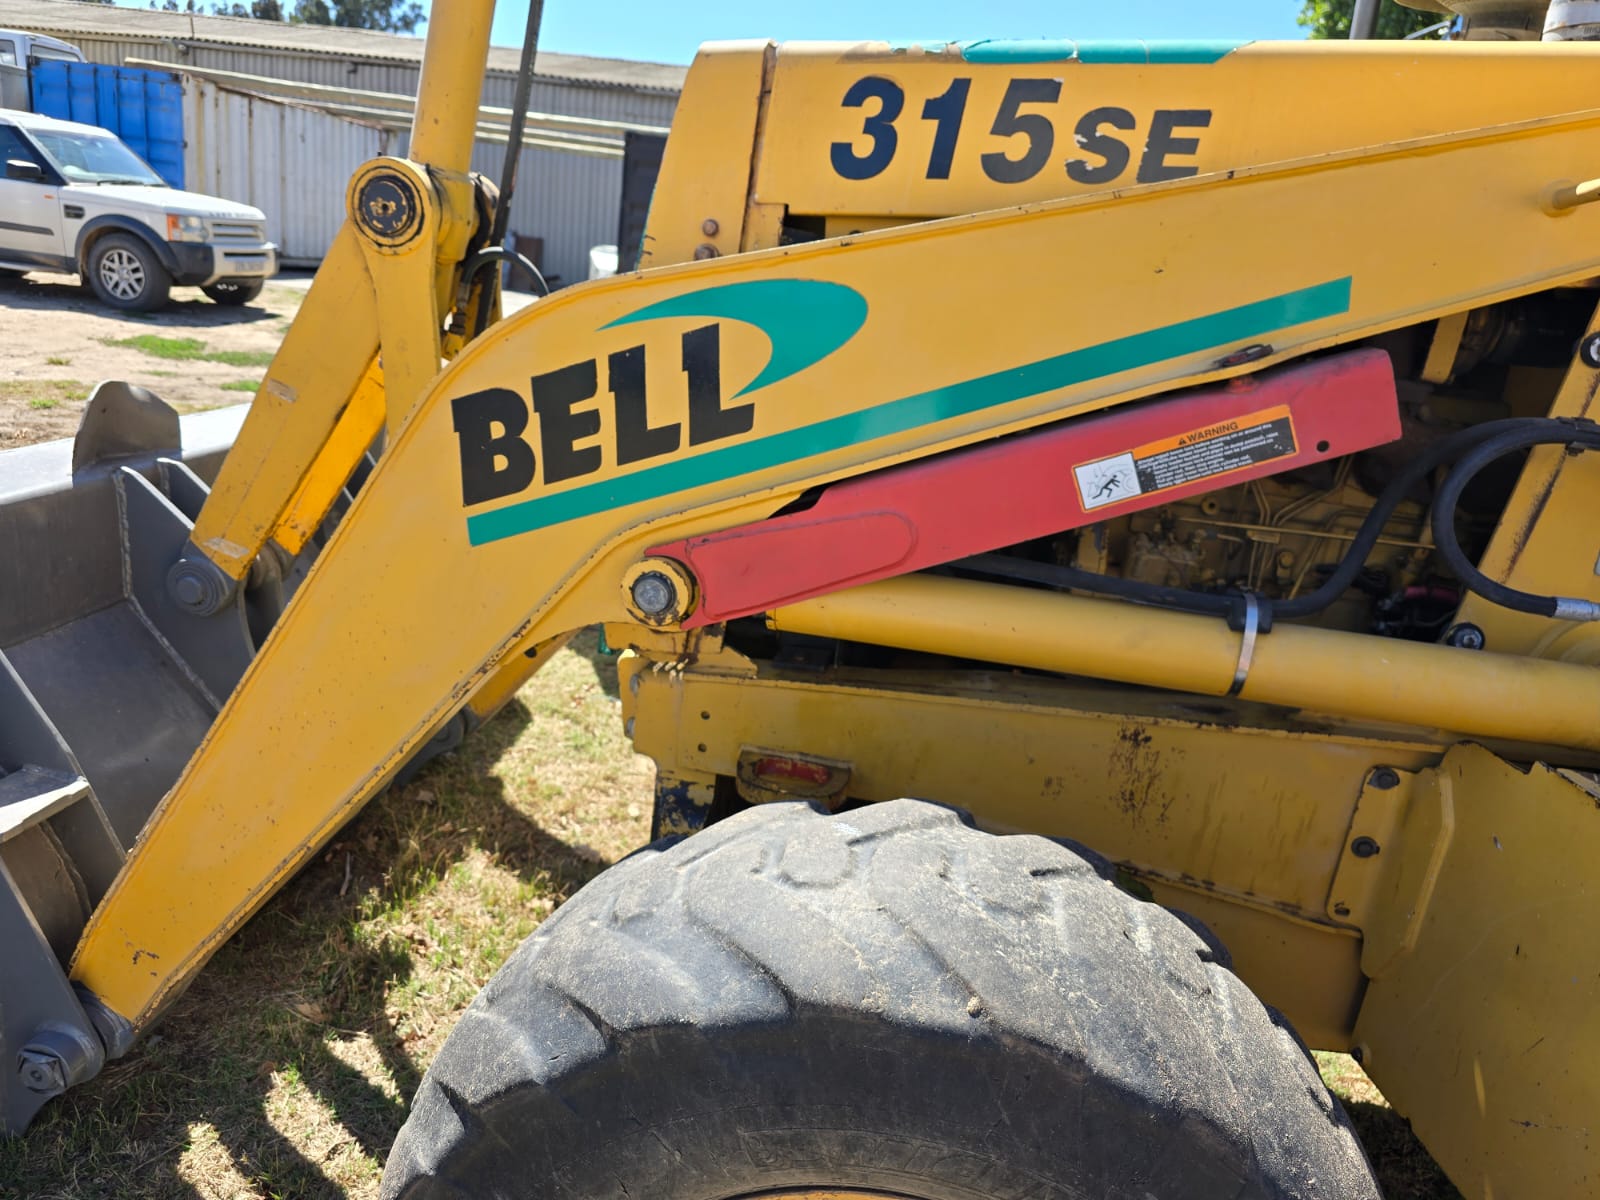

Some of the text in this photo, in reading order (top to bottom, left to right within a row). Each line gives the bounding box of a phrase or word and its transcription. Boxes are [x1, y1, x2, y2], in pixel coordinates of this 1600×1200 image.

[830, 76, 1212, 184] 315SE
[451, 323, 755, 507] BELL
[1186, 422, 1239, 443] WARNING
